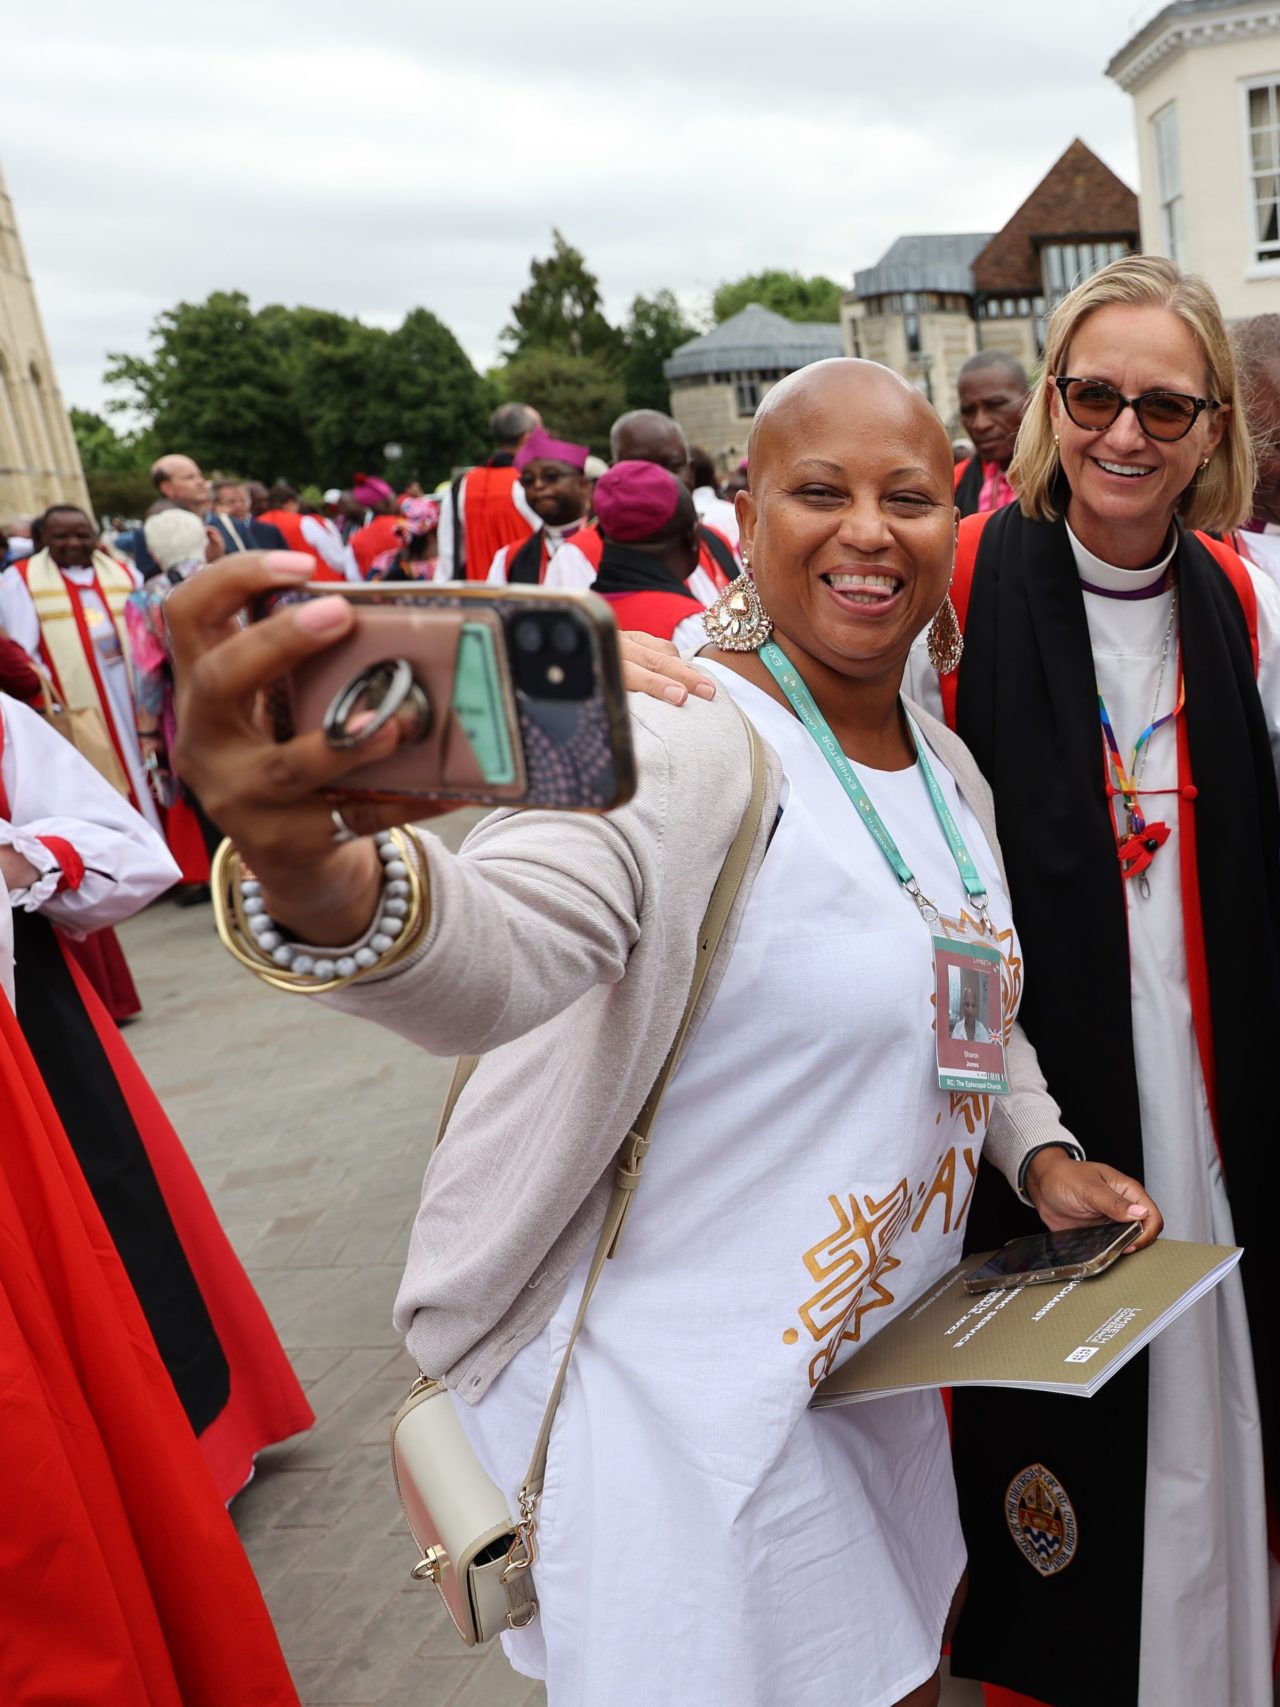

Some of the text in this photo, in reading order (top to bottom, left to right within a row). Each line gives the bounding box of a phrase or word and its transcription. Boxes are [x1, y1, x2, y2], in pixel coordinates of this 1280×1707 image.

[790, 692, 818, 732] LAMBETH
[821, 735, 858, 791] EXHIBITOR
[956, 1079, 965, 1088] The
[965, 1080, 987, 1089] Episcopal
[986, 1082, 1002, 1090] Church
[952, 1310, 997, 1349] SERVICE
[1089, 1307, 1132, 1343] CONFERENCE
[1097, 1307, 1143, 1344] LAMBETH
